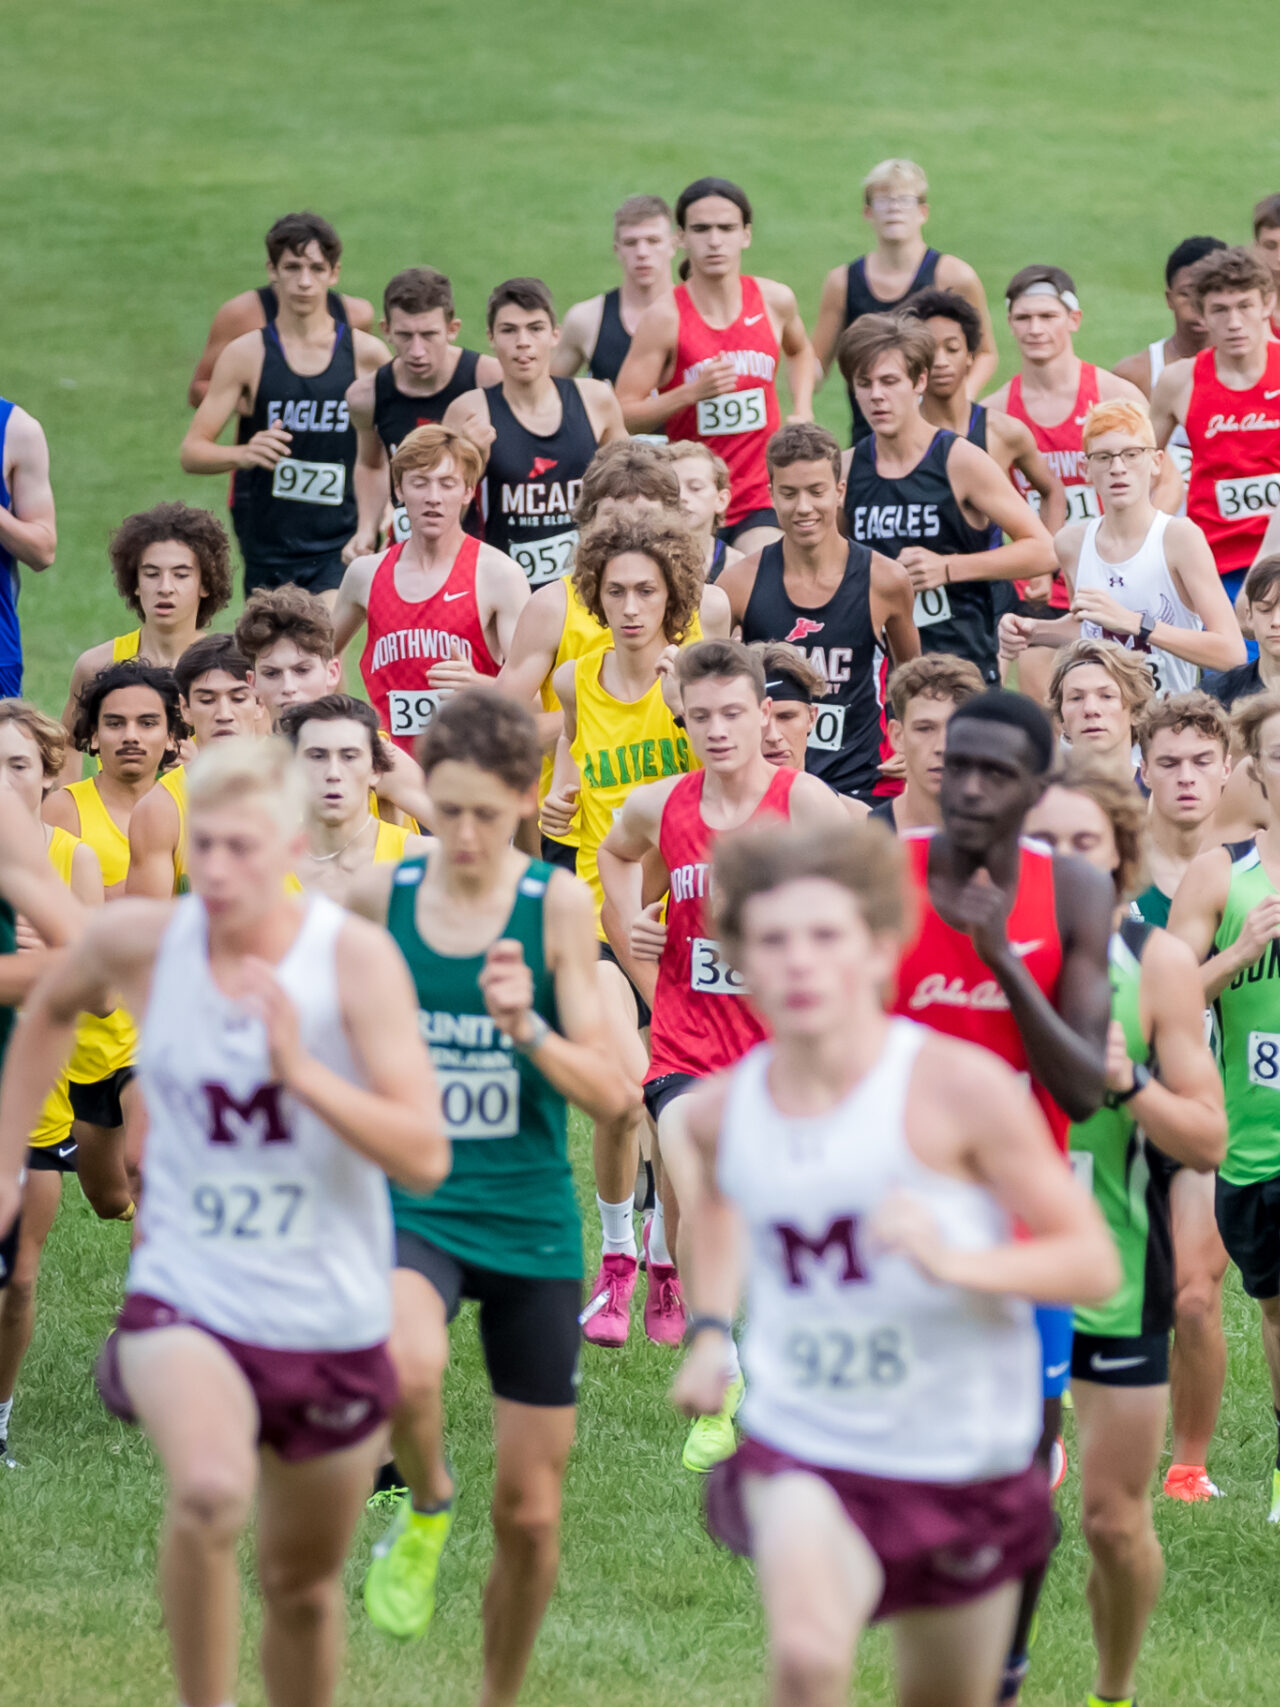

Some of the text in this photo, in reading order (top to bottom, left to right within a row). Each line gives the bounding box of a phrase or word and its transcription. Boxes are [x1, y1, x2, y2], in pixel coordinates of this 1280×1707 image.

[267, 400, 350, 432] EAGLES
[703, 396, 760, 429] 395
[1204, 414, 1239, 439] John
[278, 465, 338, 497] 972
[854, 504, 941, 541] EAGLES
[394, 697, 440, 730] 39
[203, 1080, 293, 1145] M
[441, 1081, 510, 1127] 00
[192, 1184, 305, 1239] 927
[775, 1216, 867, 1288] M
[787, 1326, 907, 1390] 928
